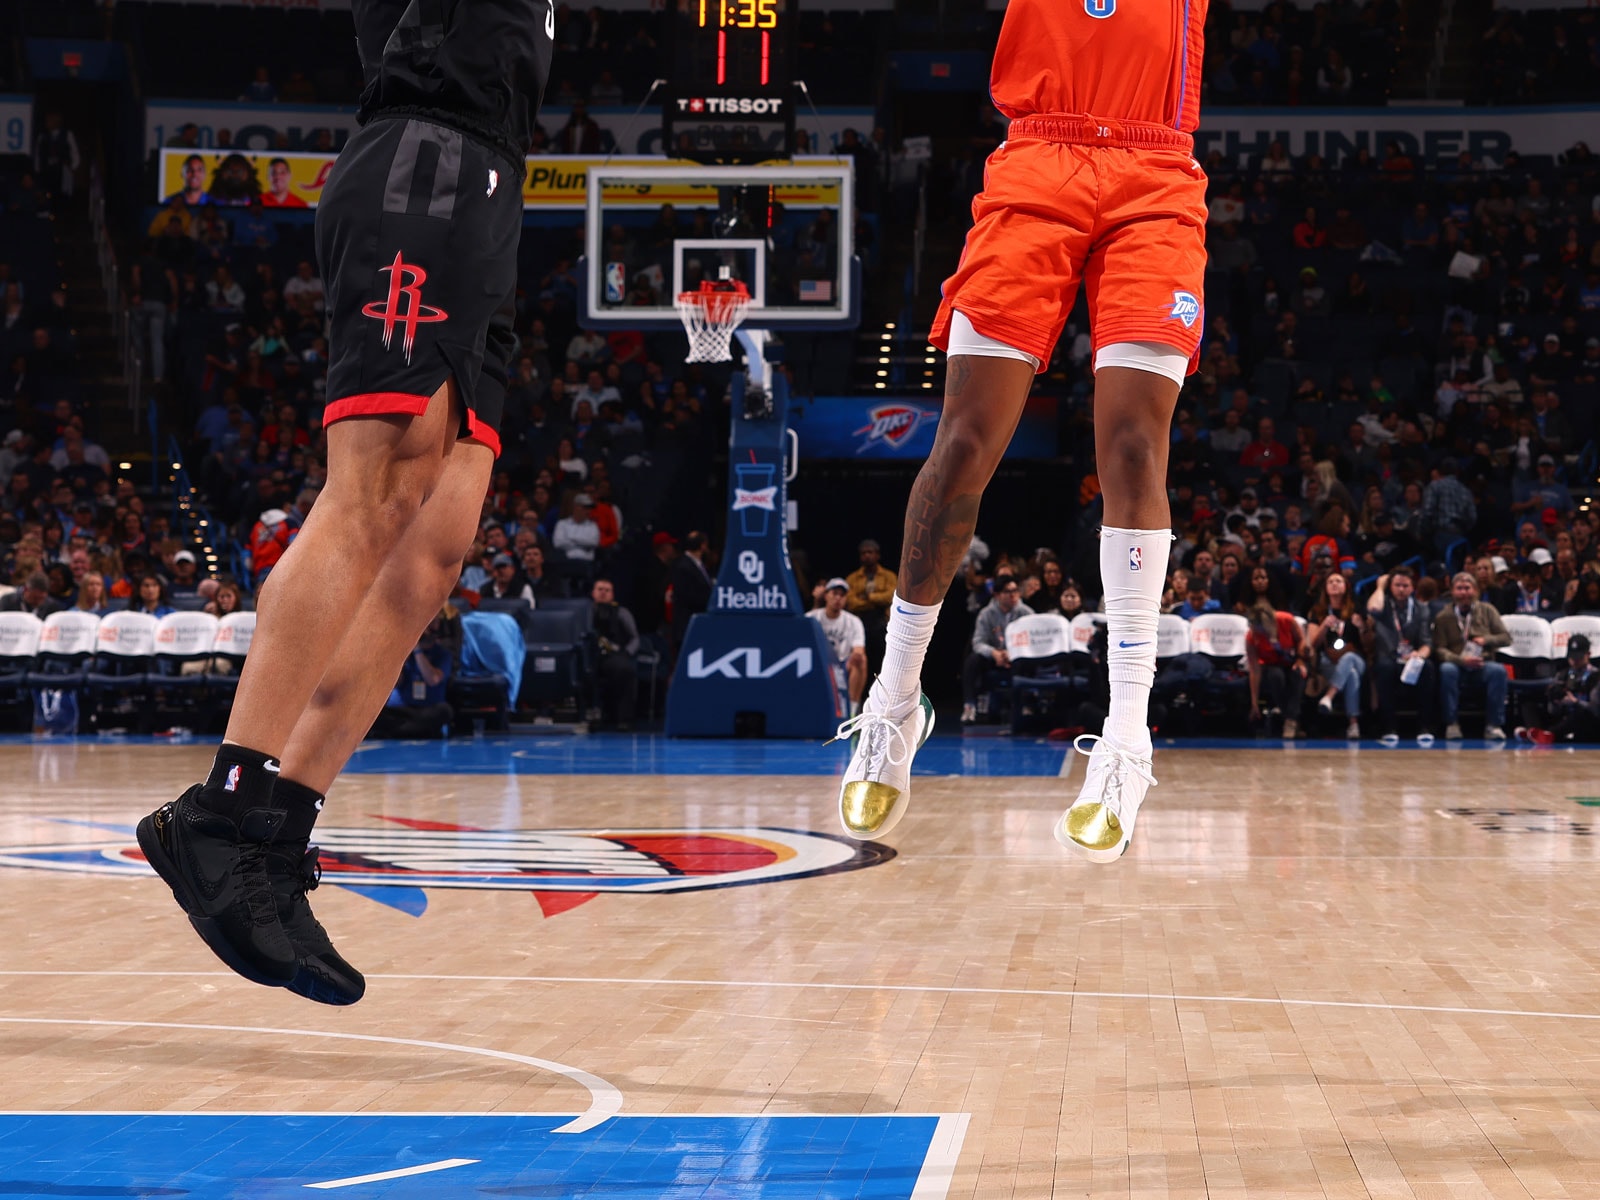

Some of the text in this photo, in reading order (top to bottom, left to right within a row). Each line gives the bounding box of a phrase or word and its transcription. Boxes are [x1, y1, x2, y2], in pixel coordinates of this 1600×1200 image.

[716, 29, 771, 87] 11
[705, 98, 783, 114] TISSOT
[868, 411, 911, 440] OKC
[738, 551, 764, 584] OU
[717, 585, 787, 609] Health
[688, 648, 812, 678] KIA
